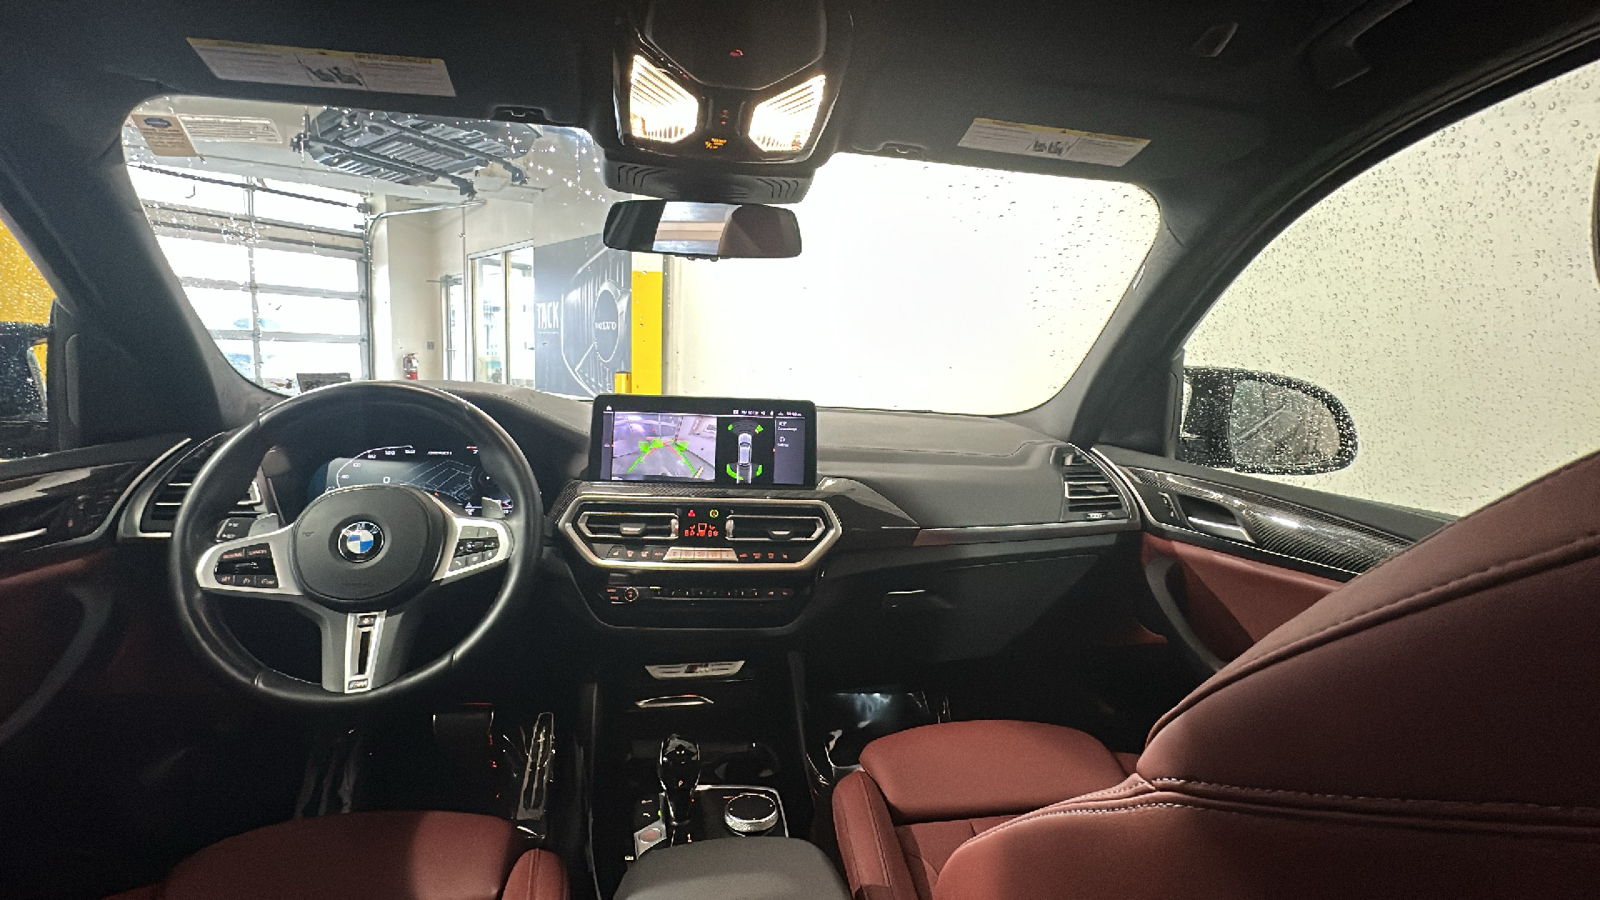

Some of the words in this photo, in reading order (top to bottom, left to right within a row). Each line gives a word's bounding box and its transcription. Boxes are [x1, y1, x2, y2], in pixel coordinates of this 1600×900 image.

[536, 301, 559, 329] TACK
[595, 321, 617, 331] VOLVO
[382, 476, 391, 484] 0
